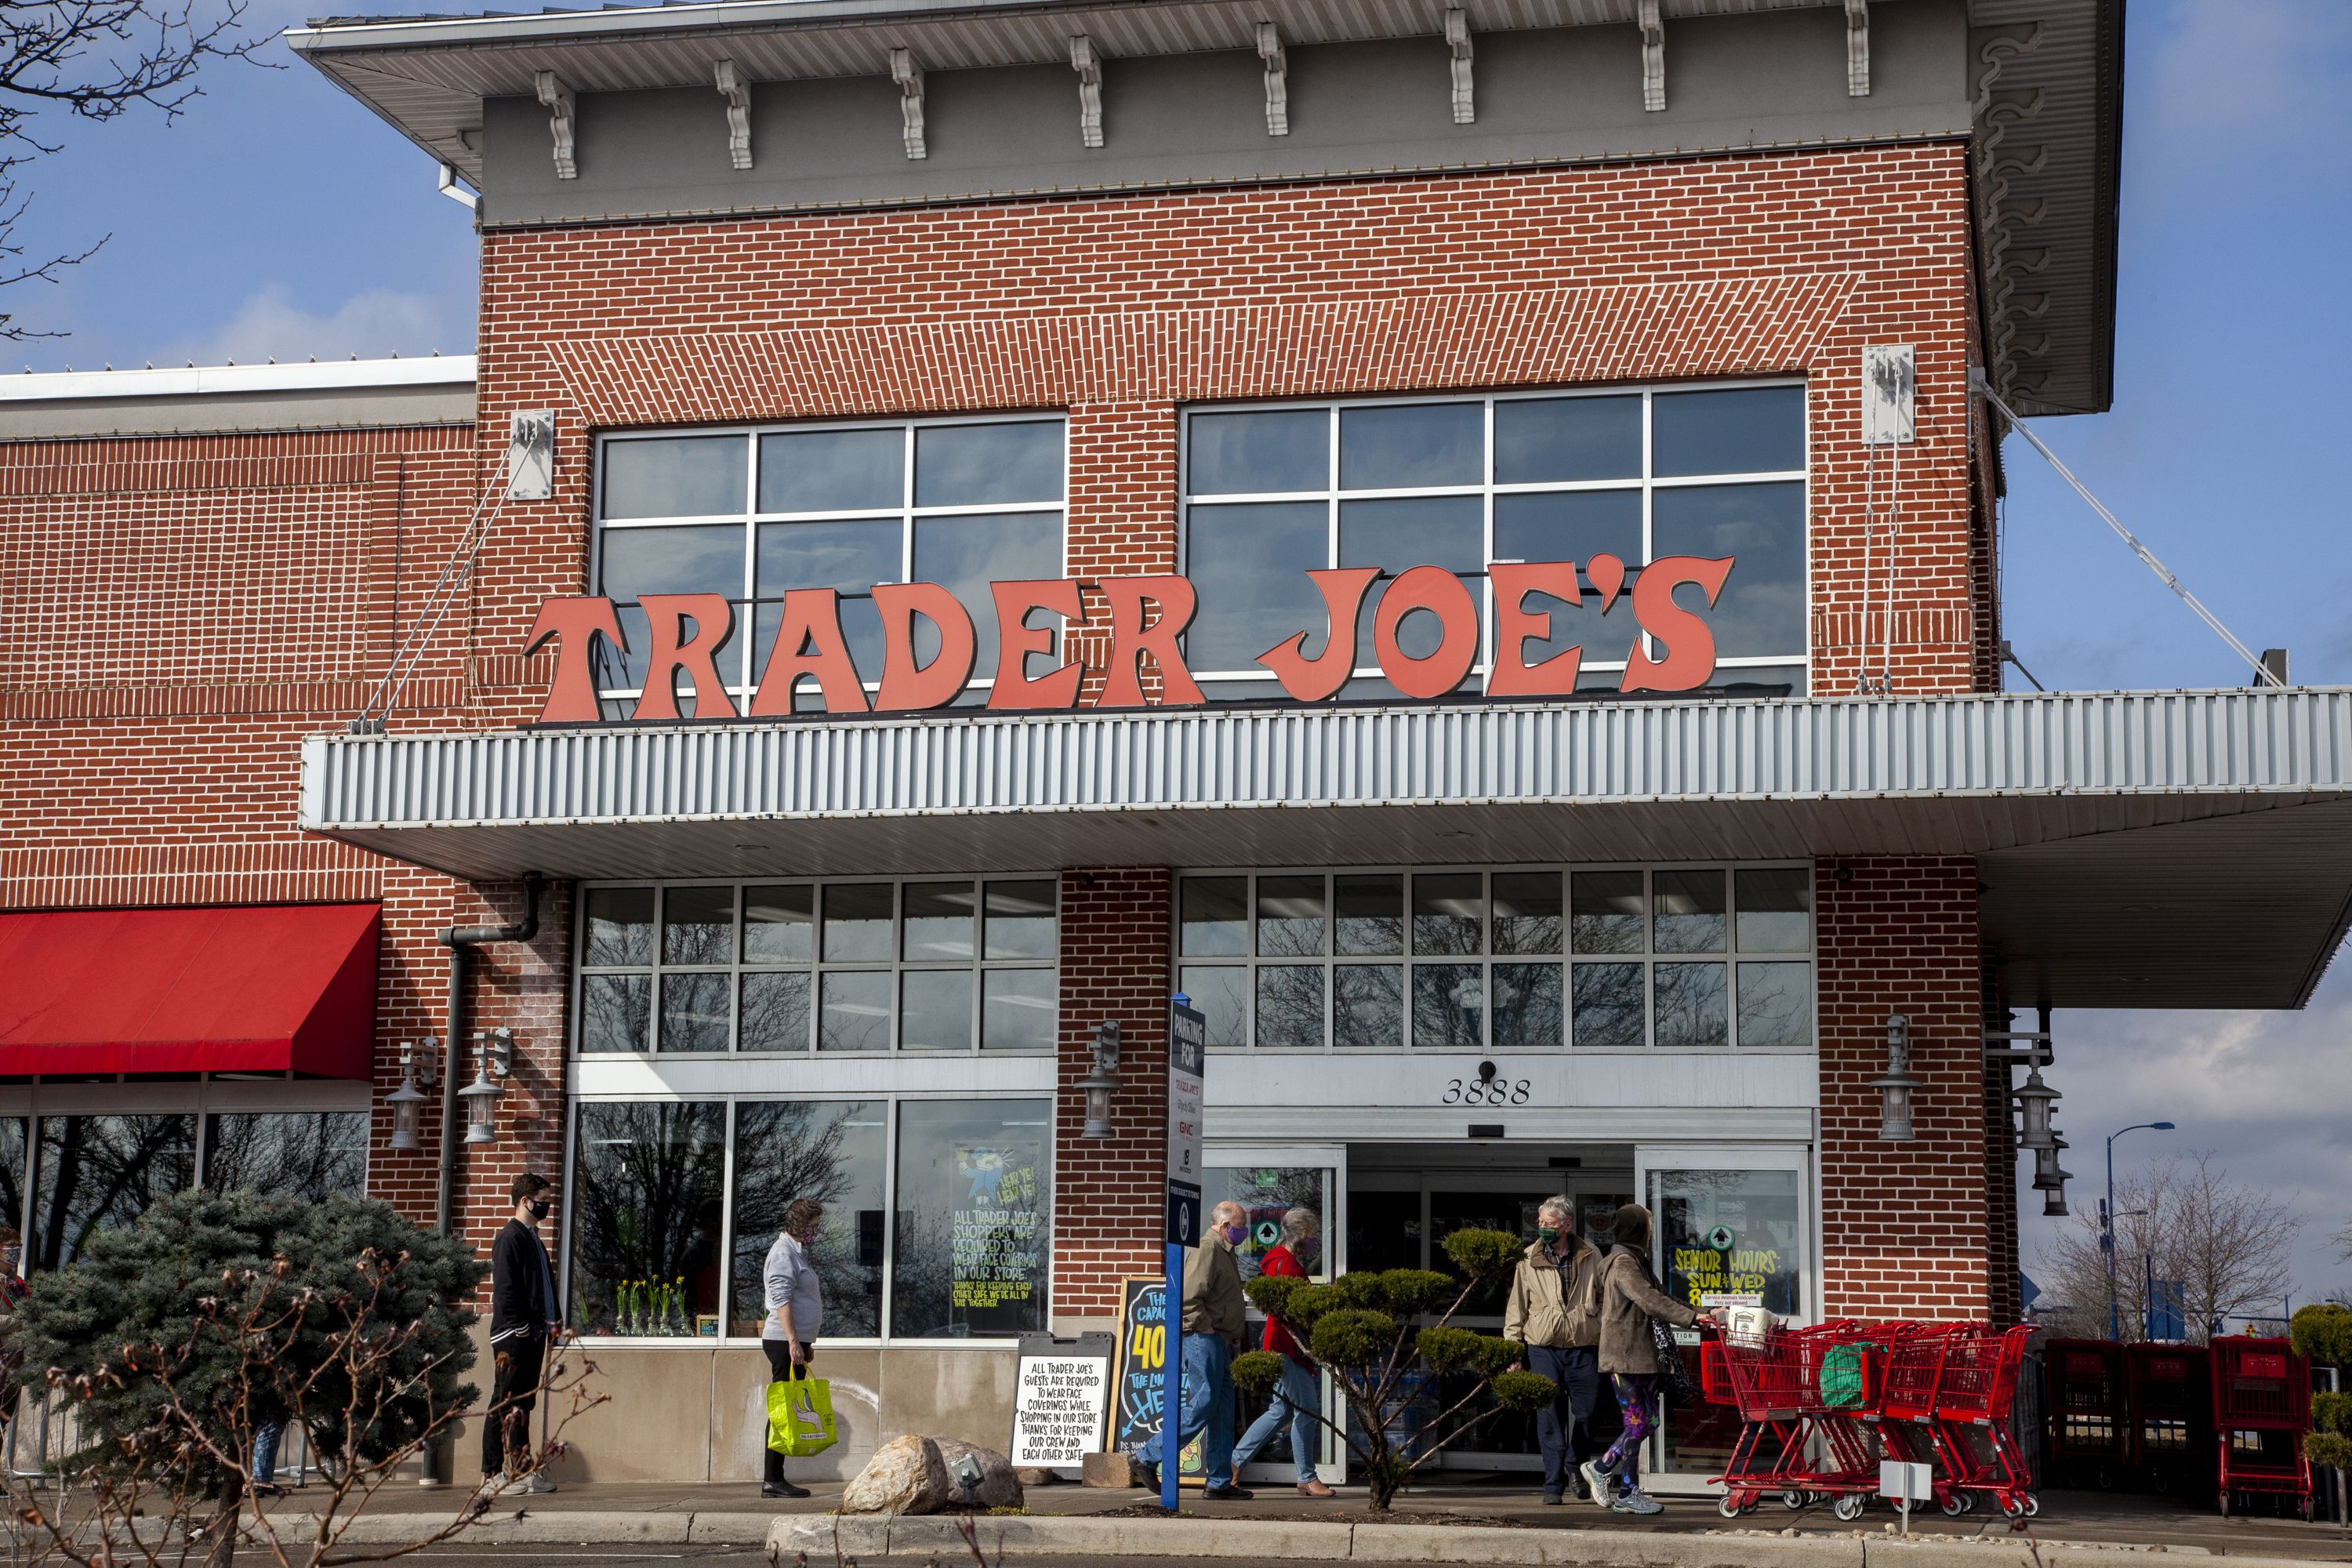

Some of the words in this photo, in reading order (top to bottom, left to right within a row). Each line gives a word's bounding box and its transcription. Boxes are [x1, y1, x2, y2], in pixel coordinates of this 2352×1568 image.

[521, 574, 1208, 724] TRADER
[1254, 552, 1736, 702] JOE'S
[1174, 1013, 1203, 1045] PARKING
[1181, 1042, 1195, 1068] FOR
[1443, 1079, 1530, 1105] 3888
[1180, 1121, 1193, 1136] GNC
[954, 1210, 973, 1225] ALL
[972, 1210, 1009, 1225] TRADER
[1011, 1210, 1037, 1226] JOE'S
[954, 1225, 1011, 1239] SHOPPERS
[1014, 1226, 1035, 1240] ARE
[953, 1239, 1001, 1253] REQUIRED
[1001, 1240, 1015, 1253] TO
[953, 1253, 978, 1267] WEAR
[979, 1254, 999, 1267] FACE
[1675, 1248, 1721, 1272] SENIOR
[1729, 1249, 1781, 1274] HOURS:
[953, 1266, 967, 1280] IN
[970, 1266, 989, 1280] OUR
[994, 1266, 1028, 1281] STORE.
[953, 1281, 975, 1290] THANKS
[988, 1282, 1014, 1290] KEEPING
[1015, 1282, 1033, 1291] EACH
[953, 1290, 972, 1299] OTHER
[1009, 1290, 1020, 1300] ALL
[1021, 1290, 1029, 1300] IN
[953, 1298, 966, 1307] THIS
[1031, 1363, 1046, 1374] ALL
[1047, 1363, 1075, 1374] TRADER
[1076, 1363, 1094, 1374] JOE'S
[1024, 1374, 1049, 1386] GUESTS
[1051, 1375, 1064, 1386] ARE
[1066, 1376, 1099, 1387] REQUIRED
[1128, 1373, 1148, 1388] THE
[1037, 1387, 1046, 1399] TO
[1046, 1388, 1065, 1399] WEAR
[1066, 1388, 1083, 1399] FACE
[1028, 1399, 1068, 1411] COVERINGS
[1069, 1400, 1091, 1411] WHILE
[1020, 1410, 1052, 1423] SHOPPING
[1054, 1413, 1061, 1423] IN
[1062, 1413, 1076, 1423] OUR
[1077, 1413, 1098, 1424] STORE.
[1022, 1424, 1048, 1436] THANKS
[1050, 1425, 1062, 1436] FOR
[1064, 1425, 1093, 1436] KEEPING
[1029, 1436, 1044, 1447] OUR
[1046, 1436, 1066, 1448] CREW
[1066, 1437, 1080, 1448] AND
[1022, 1449, 1040, 1460] EACH
[1042, 1449, 1063, 1461] OTHER
